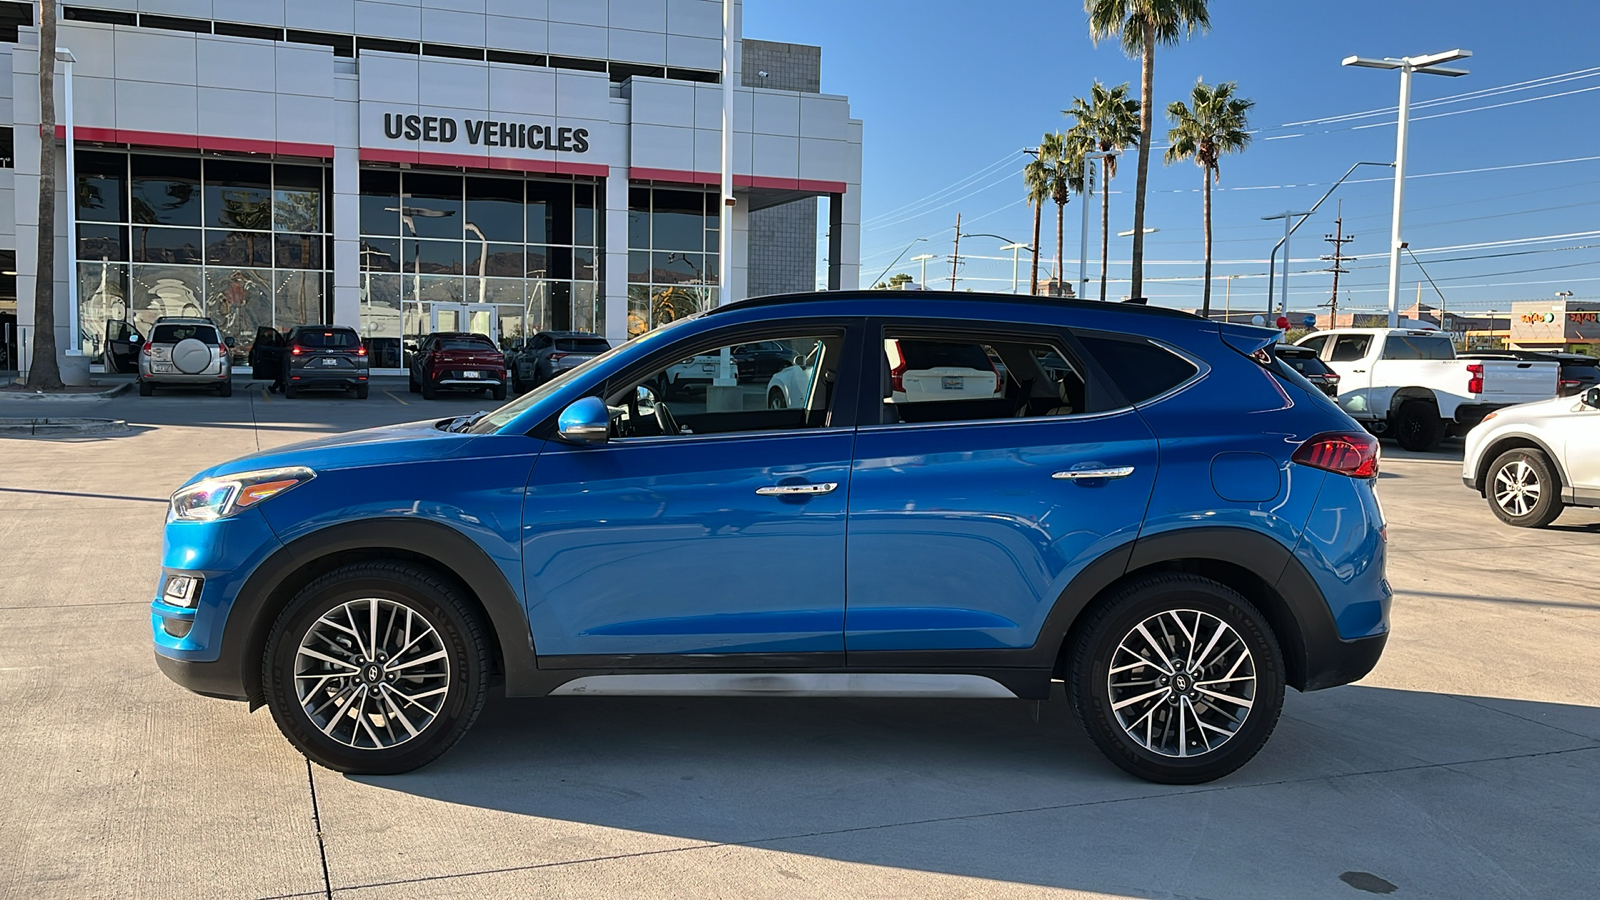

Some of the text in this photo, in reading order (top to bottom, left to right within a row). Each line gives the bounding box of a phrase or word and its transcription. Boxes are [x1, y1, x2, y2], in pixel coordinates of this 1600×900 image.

[384, 113, 589, 153] USED VEHICLES
[446, 625, 467, 680] MICHELIN
